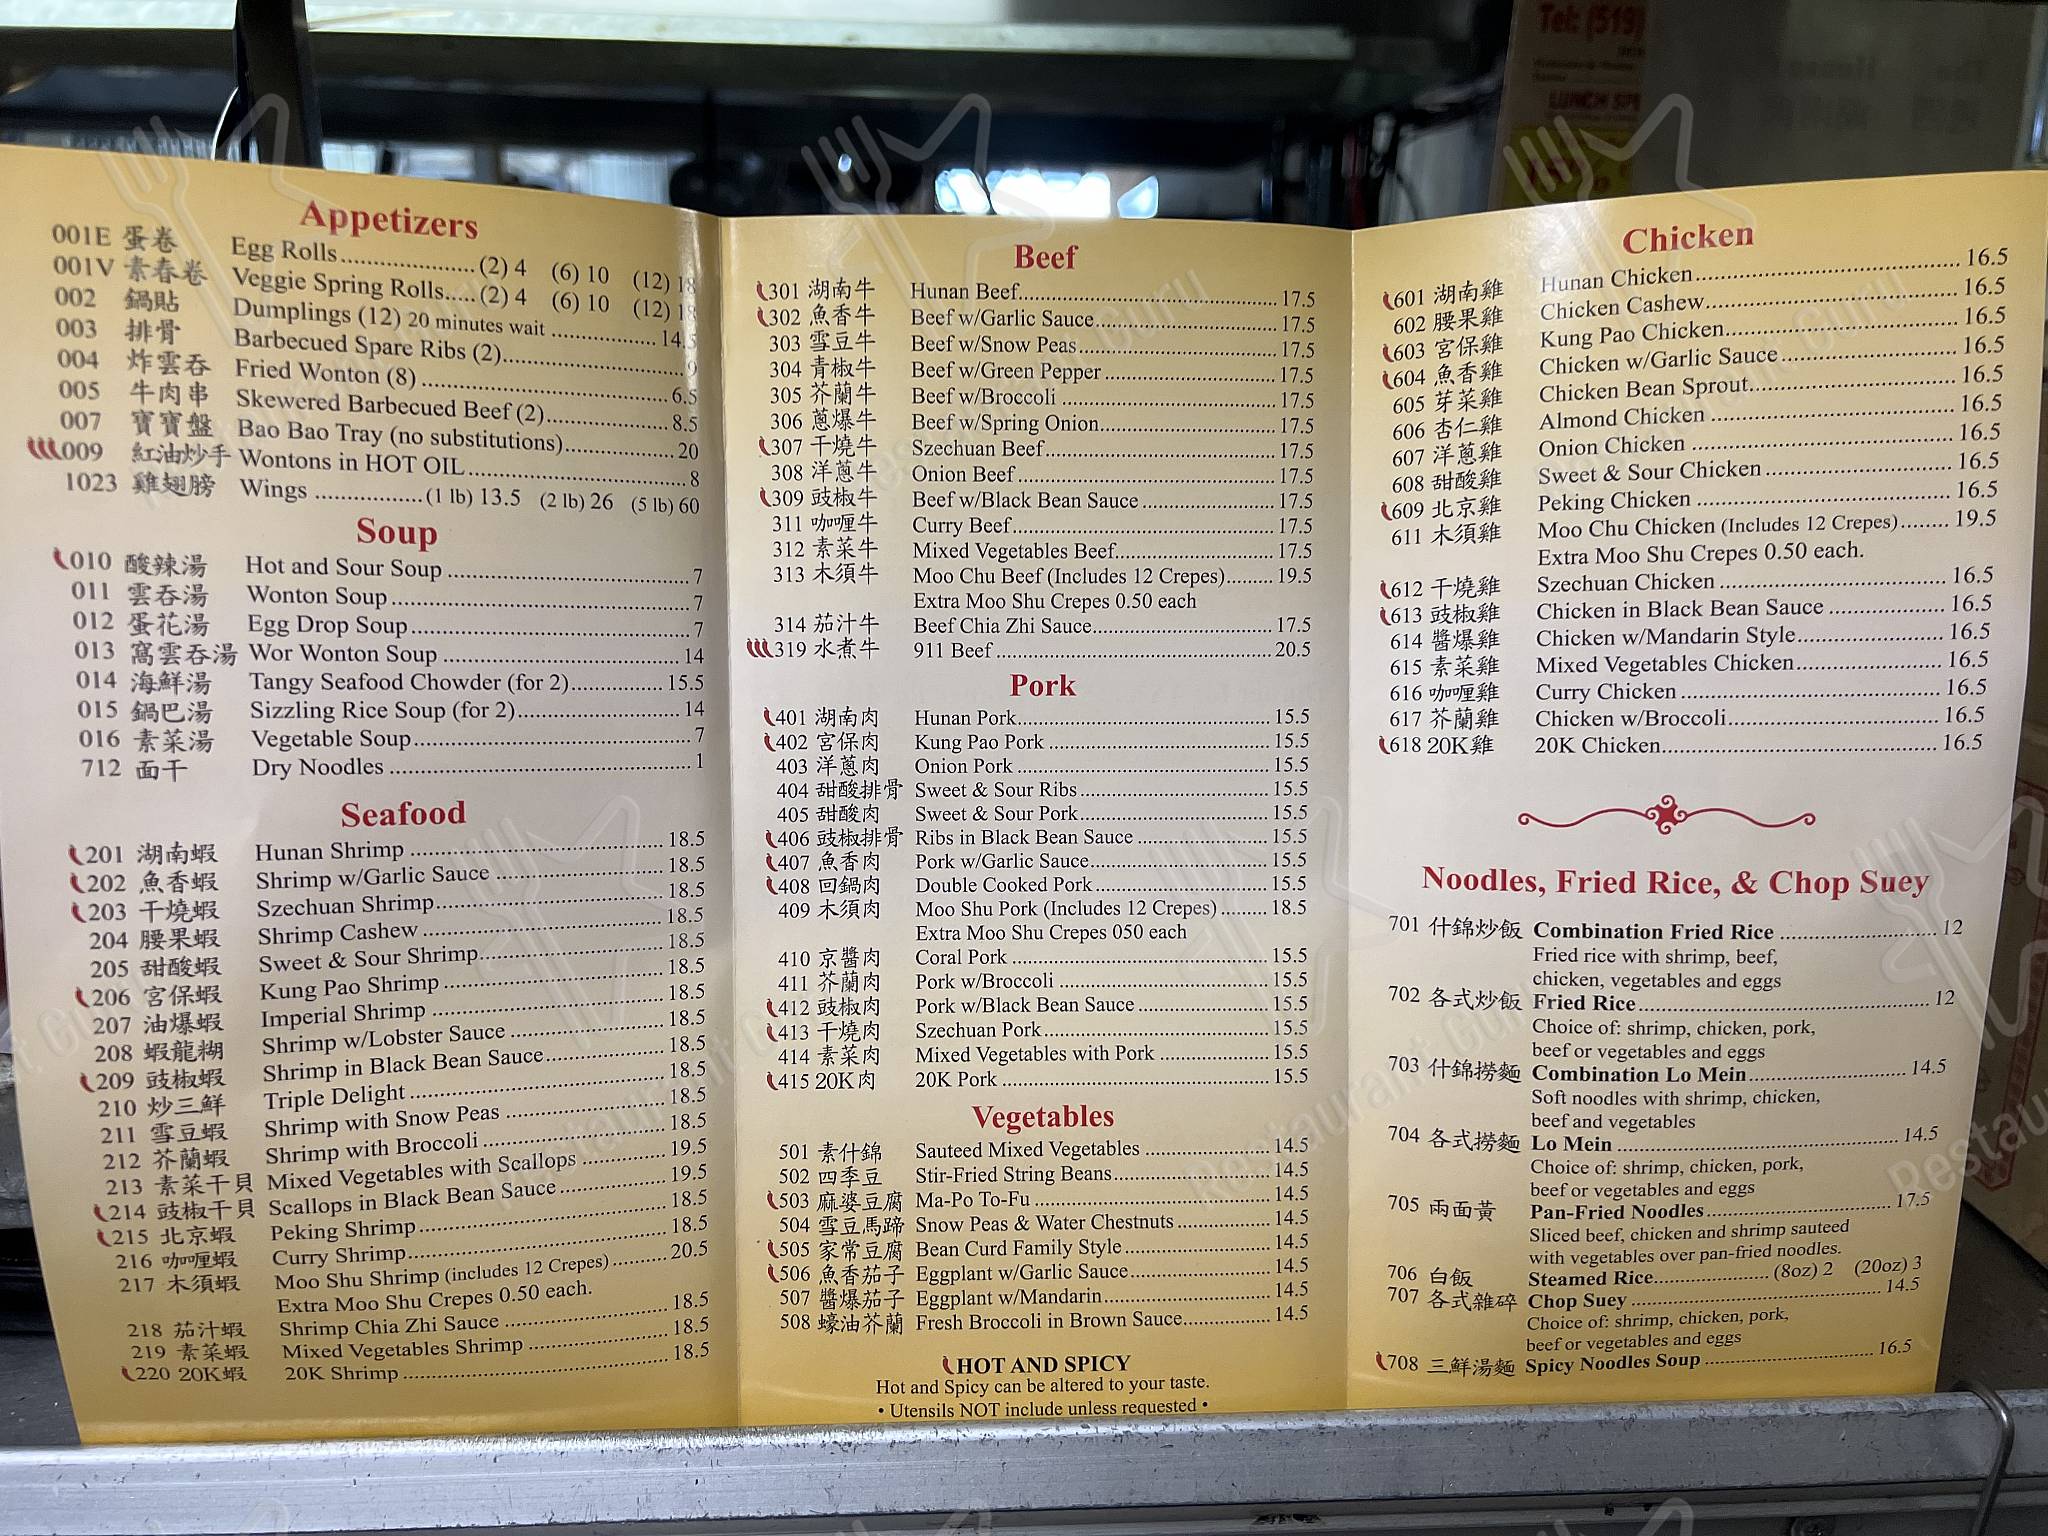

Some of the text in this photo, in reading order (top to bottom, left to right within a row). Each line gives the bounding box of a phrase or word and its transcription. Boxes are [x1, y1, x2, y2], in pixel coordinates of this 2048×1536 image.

[299, 199, 479, 241] Appetizers
[51, 223, 112, 247] 001E
[1622, 223, 1754, 255] Chicken
[231, 235, 275, 263] Egg
[479, 255, 509, 281] (2)
[513, 258, 528, 277] 4
[551, 261, 580, 287] (6)
[588, 264, 610, 285] 10
[632, 269, 671, 296] (12)
[1013, 243, 1080, 270] Beef
[1541, 275, 1604, 293] Hunan
[1967, 247, 2009, 267] 16.5
[54, 286, 97, 308] 002
[768, 282, 799, 301] 301
[910, 281, 970, 300] Hunan
[1283, 289, 1316, 309] 17.5
[1393, 288, 1424, 309] 601
[233, 297, 546, 337] Dumplings (12) 20 minutes wait
[239, 477, 700, 518] Wings (1 lb) 13.5 (2 lb) 26 (5 lb) 60
[356, 516, 438, 553] Soup
[69, 550, 112, 571] 010
[245, 555, 286, 575] Hot
[291, 556, 329, 576] and
[335, 556, 385, 577] Sour
[693, 567, 703, 585] 7
[774, 640, 807, 659] 319
[913, 641, 944, 659] 911
[1274, 640, 1311, 658] 20.5
[1009, 673, 1078, 697] Pork
[1389, 736, 1422, 753] 618
[1534, 736, 1577, 754] 20K
[1943, 732, 1984, 751] 16.5
[81, 758, 122, 777] 712
[251, 758, 293, 782] Dry
[696, 752, 704, 769] 1
[776, 782, 810, 799] 404
[915, 781, 968, 799] Sweet
[971, 781, 989, 798] &
[994, 781, 1035, 798] Sour
[1273, 780, 1309, 797] 15.5
[341, 799, 467, 828] Seafood
[255, 843, 324, 862] Hunan
[669, 830, 705, 848] 18.5
[1421, 865, 1931, 901] Noodles, Fried Rice, & Chop Suey
[1533, 921, 1664, 940] Combination
[1669, 923, 1724, 941] Fried
[1943, 918, 1963, 936] 12
[970, 1103, 1115, 1136] Vegetables
[778, 1192, 810, 1210] 503
[915, 1184, 1309, 1209] Ma-Po To-Fu 14.5
[1529, 1218, 1851, 1243] Sliced beef, chicken and shrimp sauteed
[273, 1274, 321, 1291] Moo
[325, 1271, 364, 1289] Shu
[444, 1263, 519, 1286] (includes
[525, 1259, 544, 1276] 12
[670, 1239, 708, 1261] 20.5
[1528, 1241, 1842, 1269] with vegetables over pan-fried noodles.
[1527, 1270, 1608, 1288] Steamed
[1773, 1261, 1819, 1283] (8oz)
[1822, 1261, 1834, 1277] 2
[1854, 1256, 1908, 1279] (20oz)
[1912, 1255, 1922, 1271] 3
[276, 1279, 593, 1314] Extra Moo Shu Crepes 0.50 each.
[284, 1365, 326, 1381] 20K
[674, 1340, 710, 1361] 18.5
[955, 1354, 1132, 1375] HOT AND SPICY
[1524, 1357, 1576, 1377] Spicy
[1579, 1354, 1651, 1372] Noodles
[1879, 1338, 1913, 1356] 16.5
[135, 1366, 171, 1381] 220
[875, 1375, 1210, 1399] Hot and Spicy can be altered to your taste.
[889, 1396, 1198, 1419] Utensils NOT include unless requested
